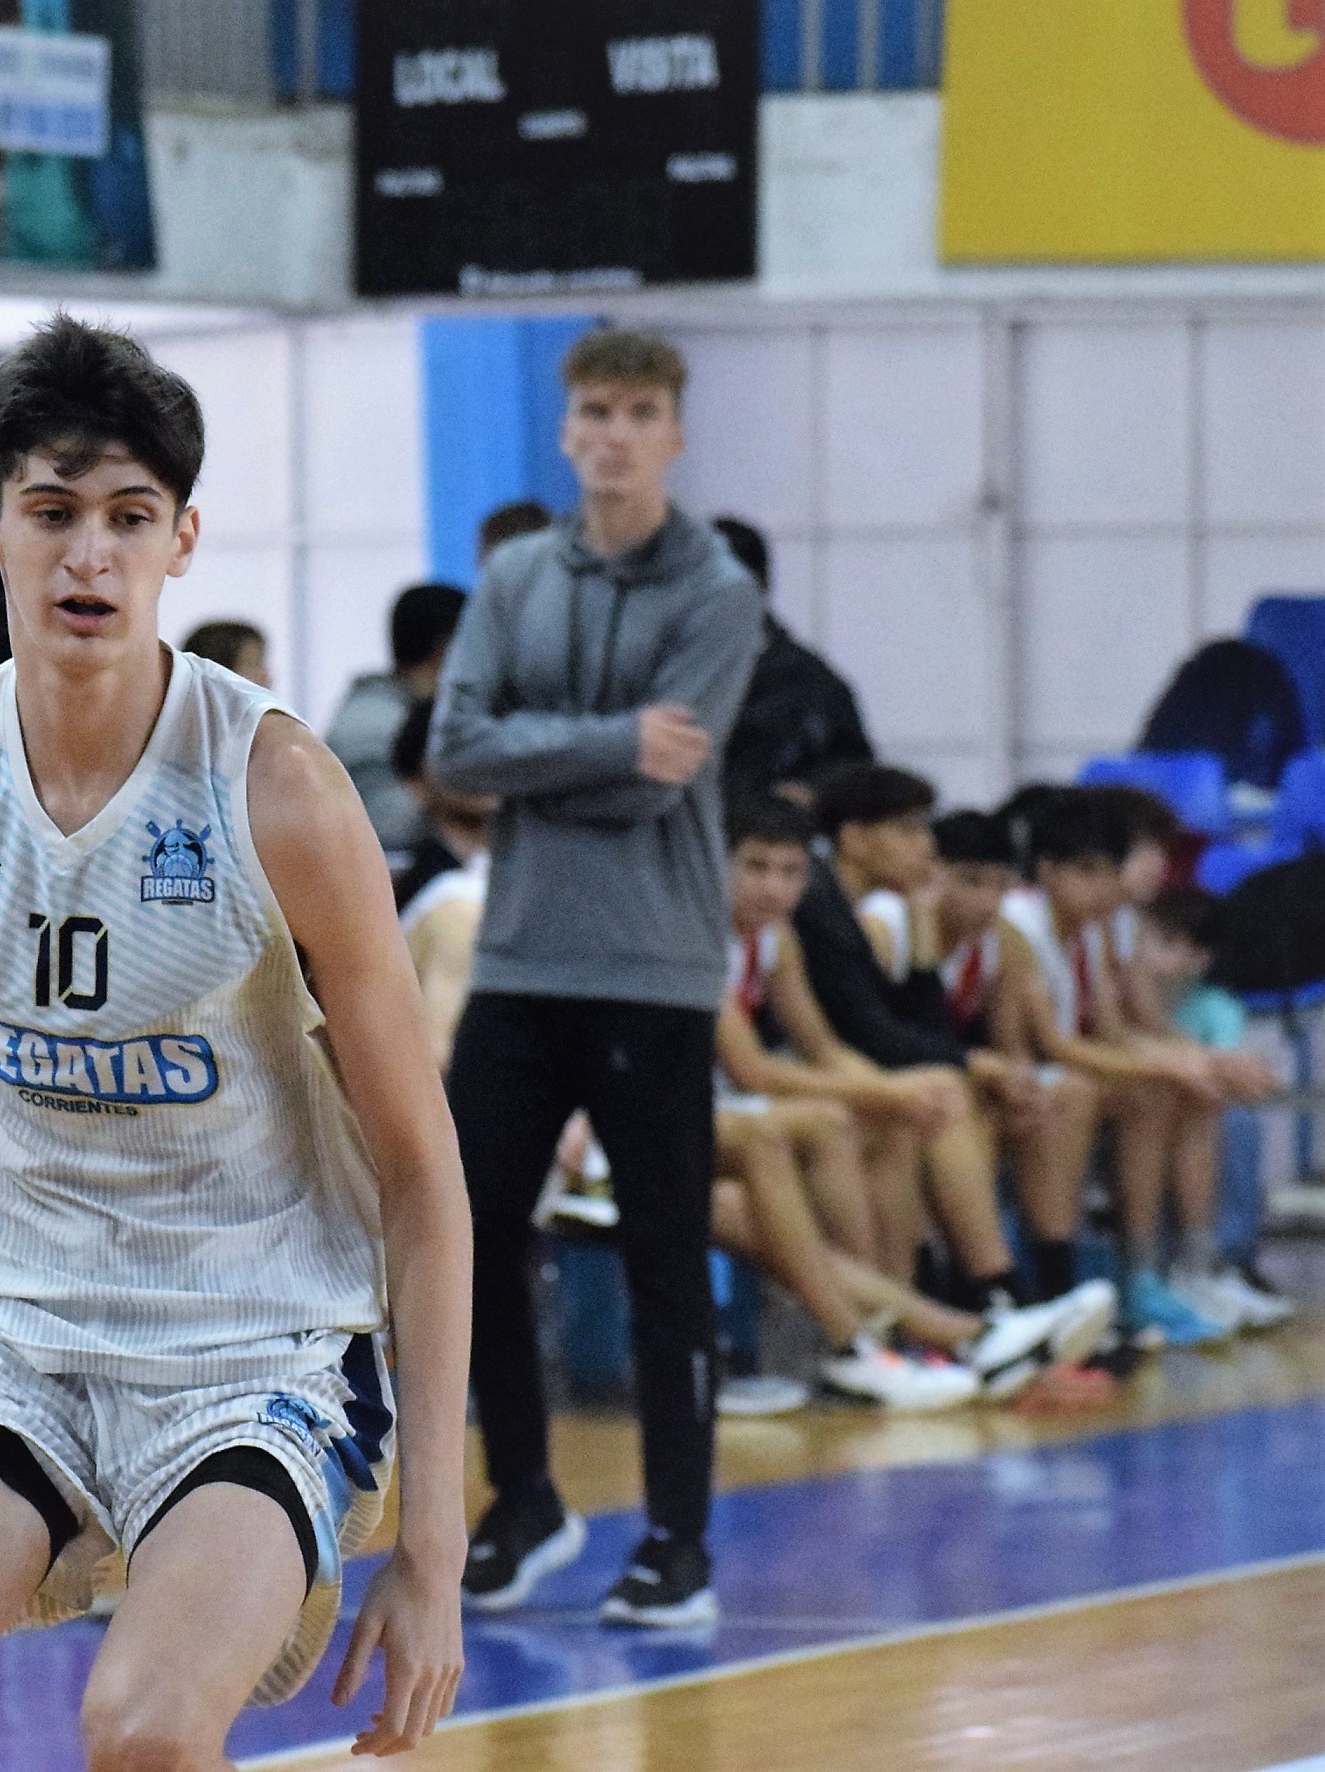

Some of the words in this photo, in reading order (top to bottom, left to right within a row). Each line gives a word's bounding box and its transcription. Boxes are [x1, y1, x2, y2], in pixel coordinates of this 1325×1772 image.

[393, 48, 505, 107] LOCAL
[608, 36, 719, 93] VISITA
[143, 877, 213, 902] REGATAS
[29, 913, 108, 1011] 10
[19, 1089, 138, 1116] CORRIENTES
